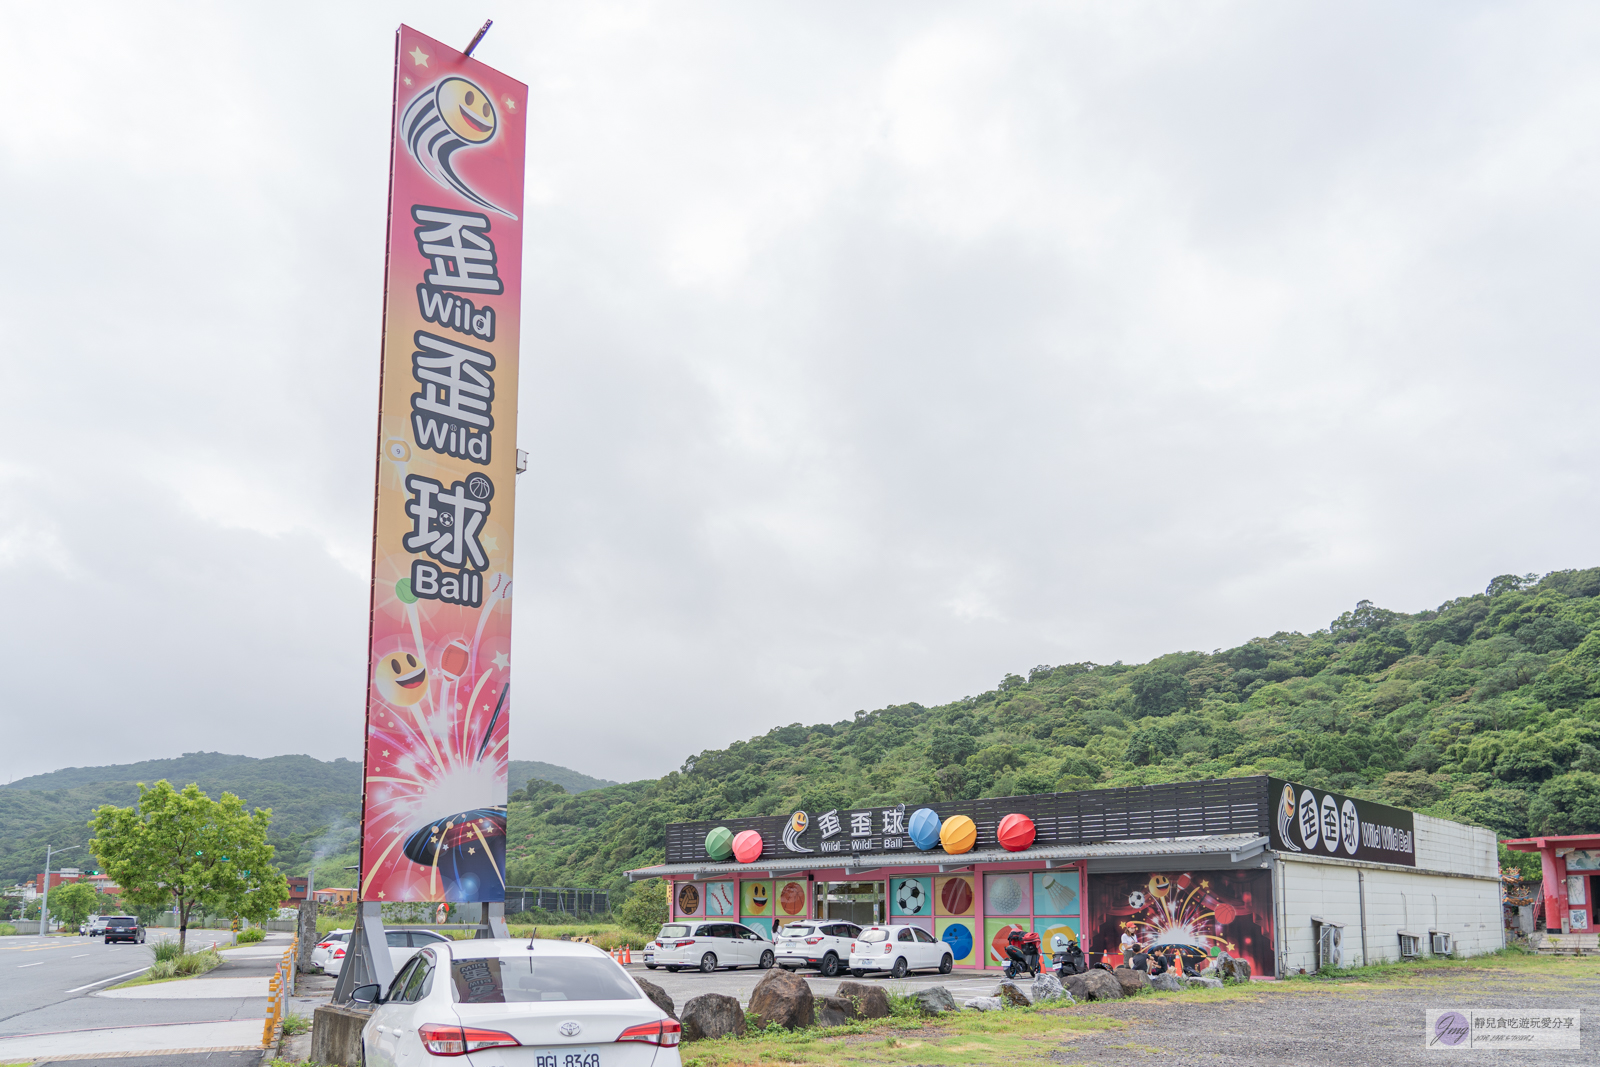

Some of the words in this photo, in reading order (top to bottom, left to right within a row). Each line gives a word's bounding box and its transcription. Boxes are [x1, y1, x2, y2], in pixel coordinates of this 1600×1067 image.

[413, 207, 502, 293] 歪
[419, 286, 493, 339] Wild
[414, 333, 493, 429] 歪
[413, 413, 489, 462] Wild
[406, 476, 491, 569] 球
[414, 562, 480, 604] Ball
[818, 803, 905, 840] 歪歪球
[820, 840, 840, 852] Wild
[851, 839, 871, 851] Wild
[884, 838, 903, 849] Ball
[1300, 798, 1357, 847] 歪歪球
[1361, 821, 1381, 848] Wild
[1381, 825, 1398, 851] Wild
[1399, 829, 1412, 853] Ball
